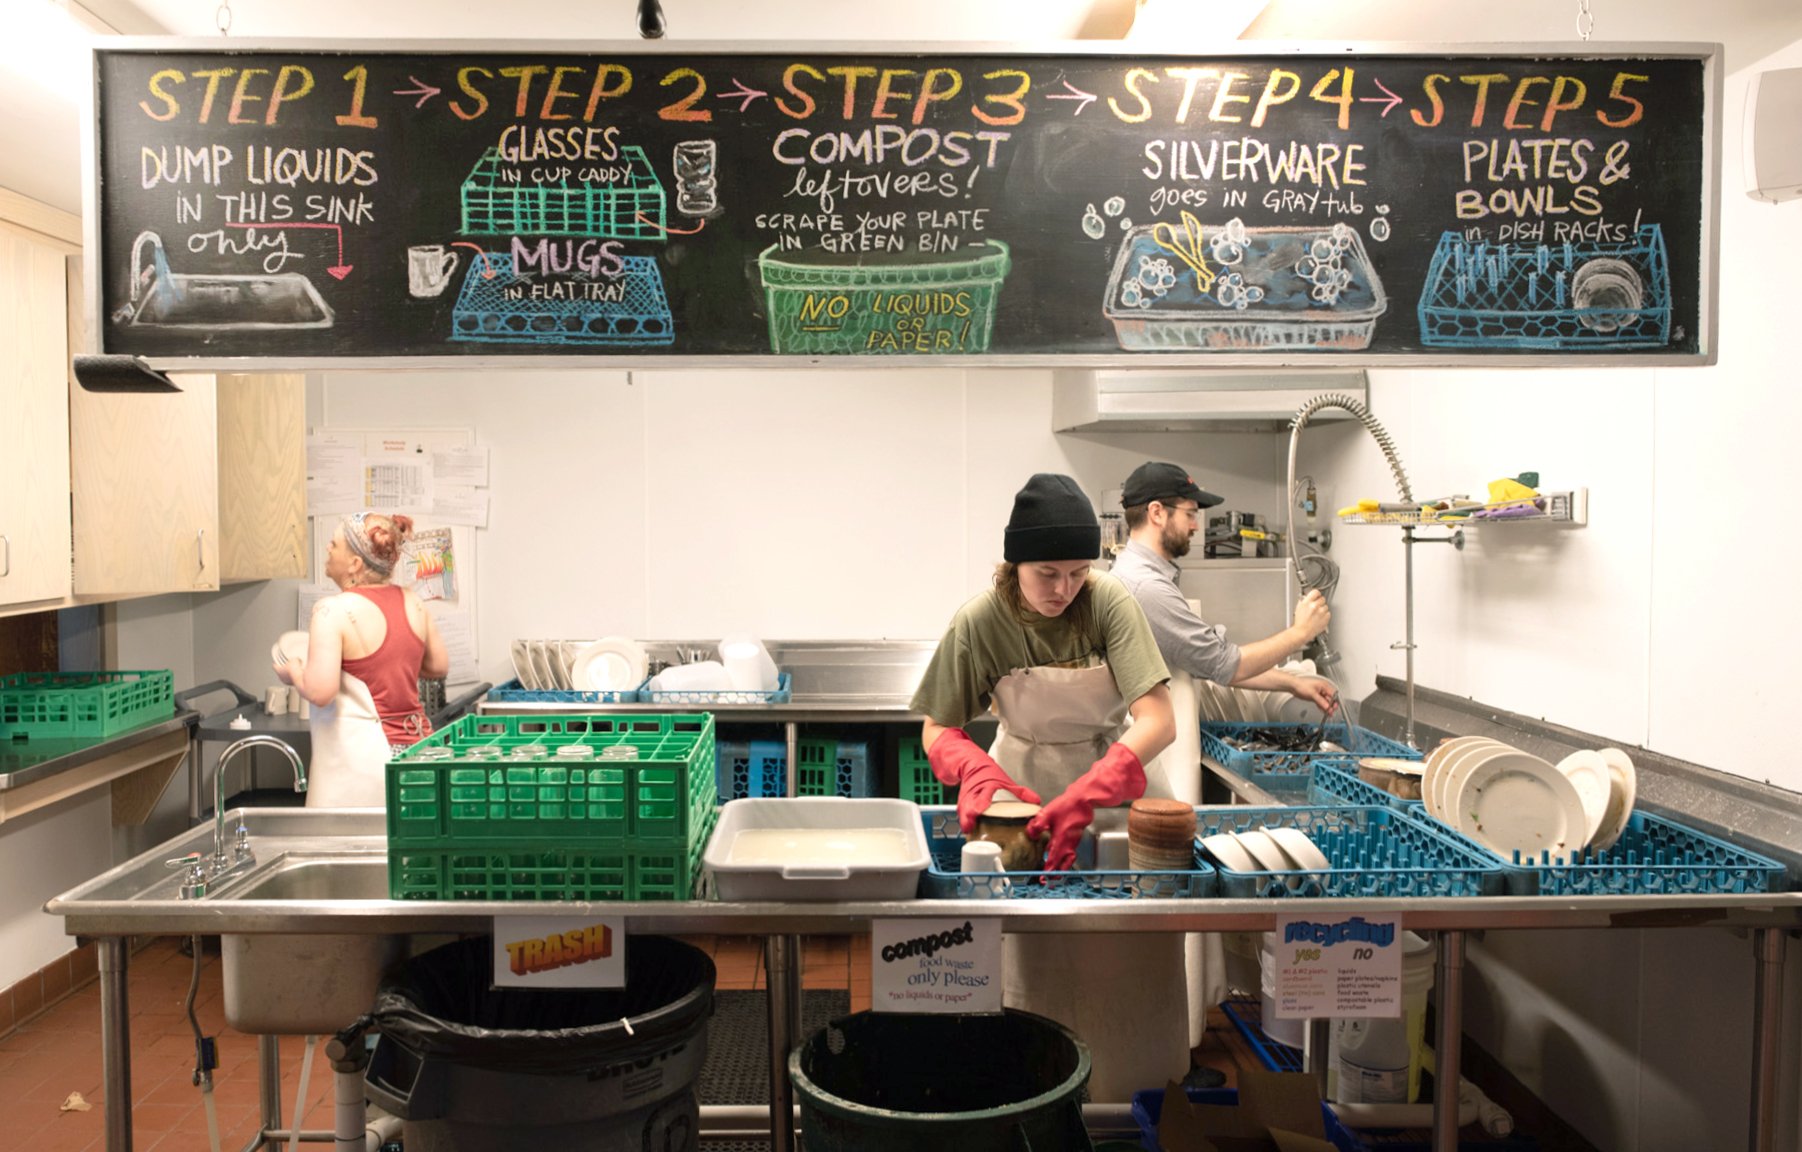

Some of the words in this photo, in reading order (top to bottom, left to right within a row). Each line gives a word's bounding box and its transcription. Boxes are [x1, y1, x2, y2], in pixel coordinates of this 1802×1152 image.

[139, 65, 315, 126] STEP
[335, 65, 378, 129] 1
[448, 64, 633, 122] STEP
[657, 67, 712, 122] 2
[774, 63, 963, 125] STEP
[971, 69, 1031, 126] 3
[1107, 66, 1302, 128] STEP
[1309, 66, 1354, 130] 4
[1410, 72, 1587, 132] STEP
[1596, 72, 1649, 128] 5
[498, 124, 621, 165] GLASSES
[772, 124, 1012, 168] COMPOST
[140, 144, 233, 189] DUMP
[247, 145, 378, 188] LIQUIDS
[531, 167, 571, 182] CUP
[578, 163, 632, 185] CADDY
[1142, 137, 1367, 190] SILVERWARE
[1463, 138, 1595, 184] PLATES
[1599, 139, 1631, 186] &
[216, 193, 293, 222] THIS
[305, 193, 375, 223] SINK
[1150, 187, 1207, 216] goes
[1263, 189, 1319, 214] GRAY
[1321, 191, 1364, 217] tub
[1455, 184, 1603, 219] BOWLS
[755, 213, 843, 232] SCRAPE
[857, 211, 907, 232] YOUR
[917, 209, 990, 231] PLATE
[1498, 220, 1544, 240] DISH
[187, 228, 304, 274] only
[511, 236, 625, 278] MUGS
[779, 234, 802, 251] IN
[820, 233, 904, 253] GREEN
[919, 231, 958, 253] BIN
[531, 281, 576, 301] FLAT
[579, 280, 626, 302] TRAY
[800, 293, 850, 320] NO
[872, 292, 971, 318] LIQUIDS
[866, 321, 970, 352] PAPER!
[897, 317, 925, 332] OR
[882, 921, 973, 963] compost
[1285, 917, 1394, 948] recycling
[505, 924, 612, 977] TRASH
[920, 955, 943, 968] food
[945, 958, 974, 969] waste
[1292, 948, 1322, 965] yes
[1352, 947, 1374, 960] no
[907, 968, 940, 986] only
[944, 968, 989, 987] please
[905, 990, 933, 1001] liquids
